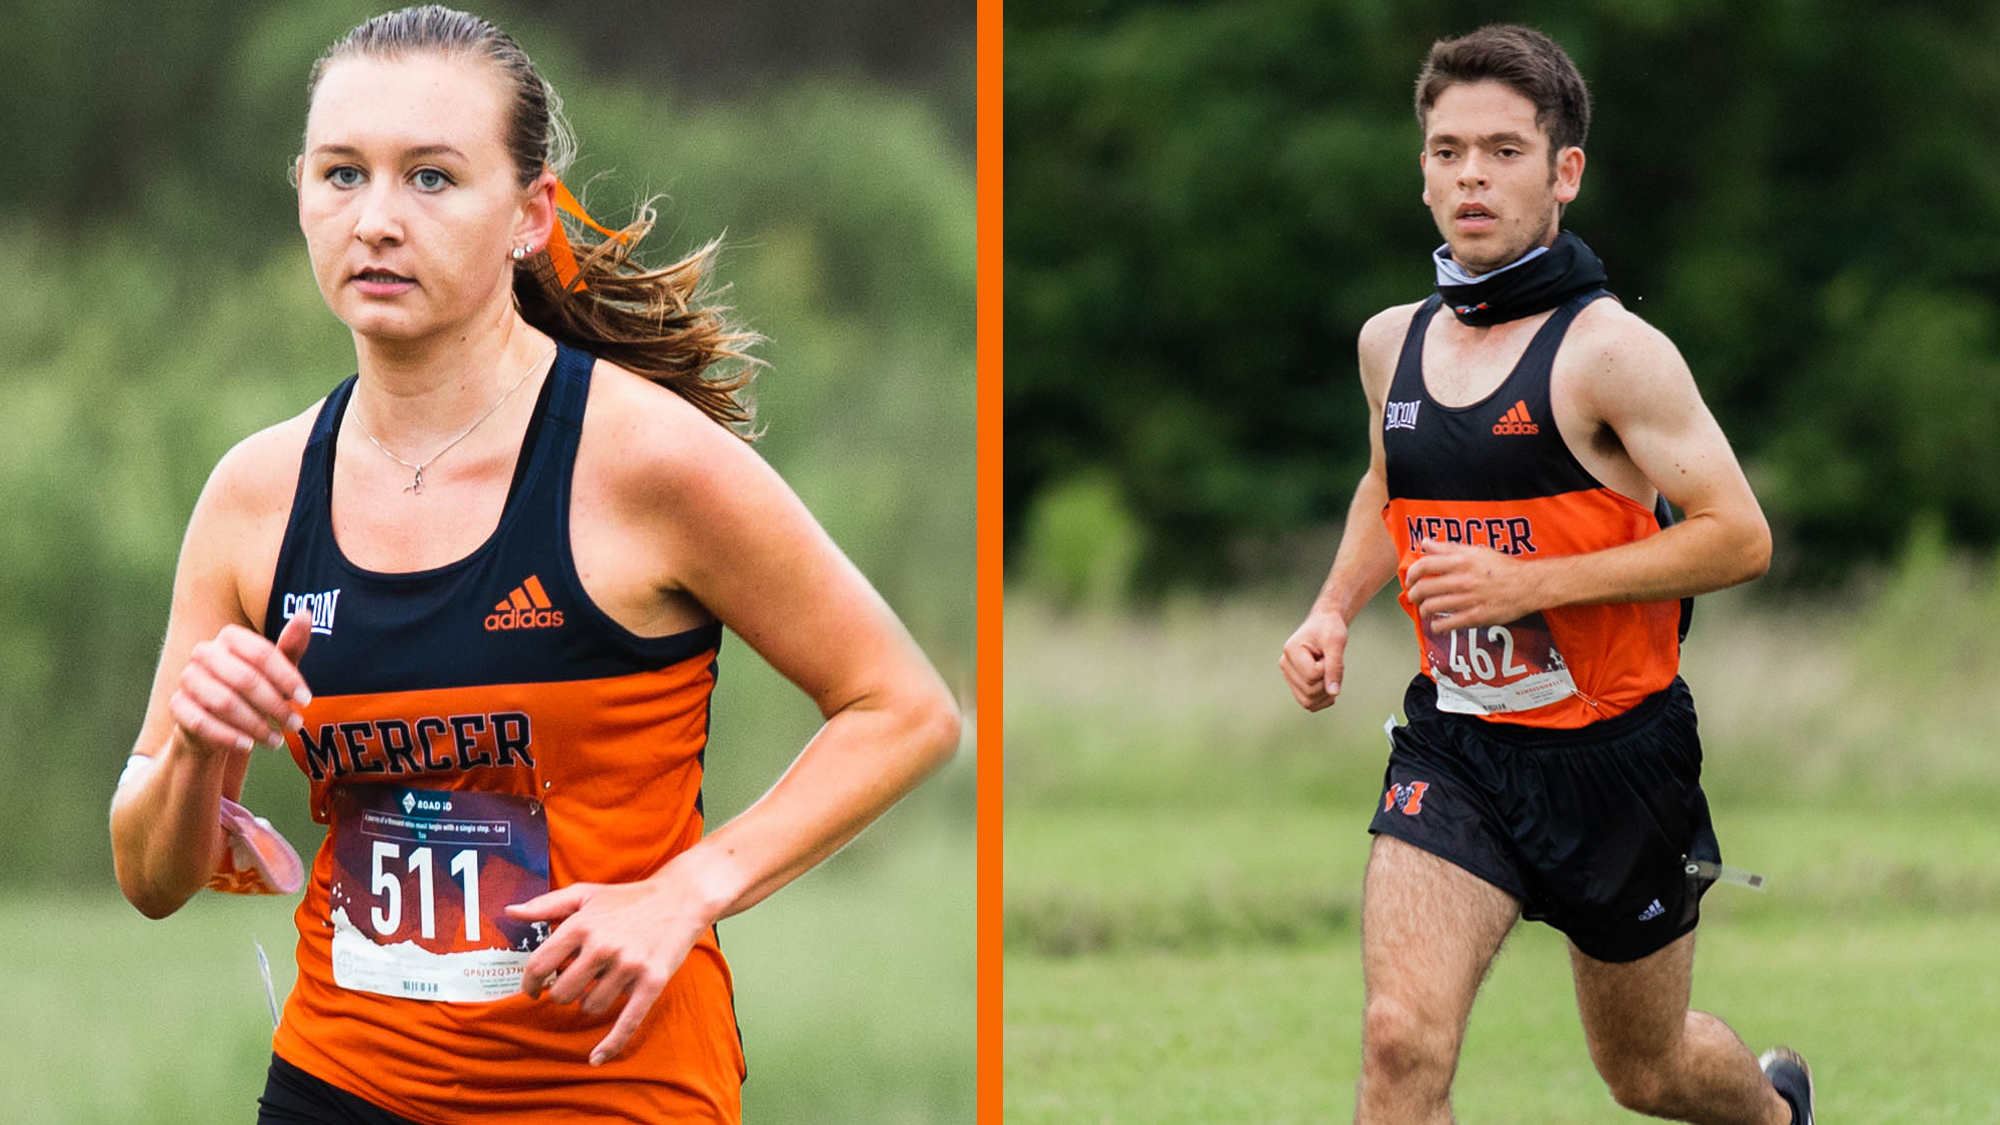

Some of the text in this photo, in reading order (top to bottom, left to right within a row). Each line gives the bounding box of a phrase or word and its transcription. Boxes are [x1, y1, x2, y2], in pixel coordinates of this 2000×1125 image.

[1492, 421, 1539, 436] adidas
[1406, 515, 1537, 556] MERCER
[484, 608, 564, 632] adidas
[1449, 625, 1528, 681] 462
[298, 710, 536, 782] MERCER
[417, 799, 441, 811] ROAD
[370, 840, 481, 942] 511
